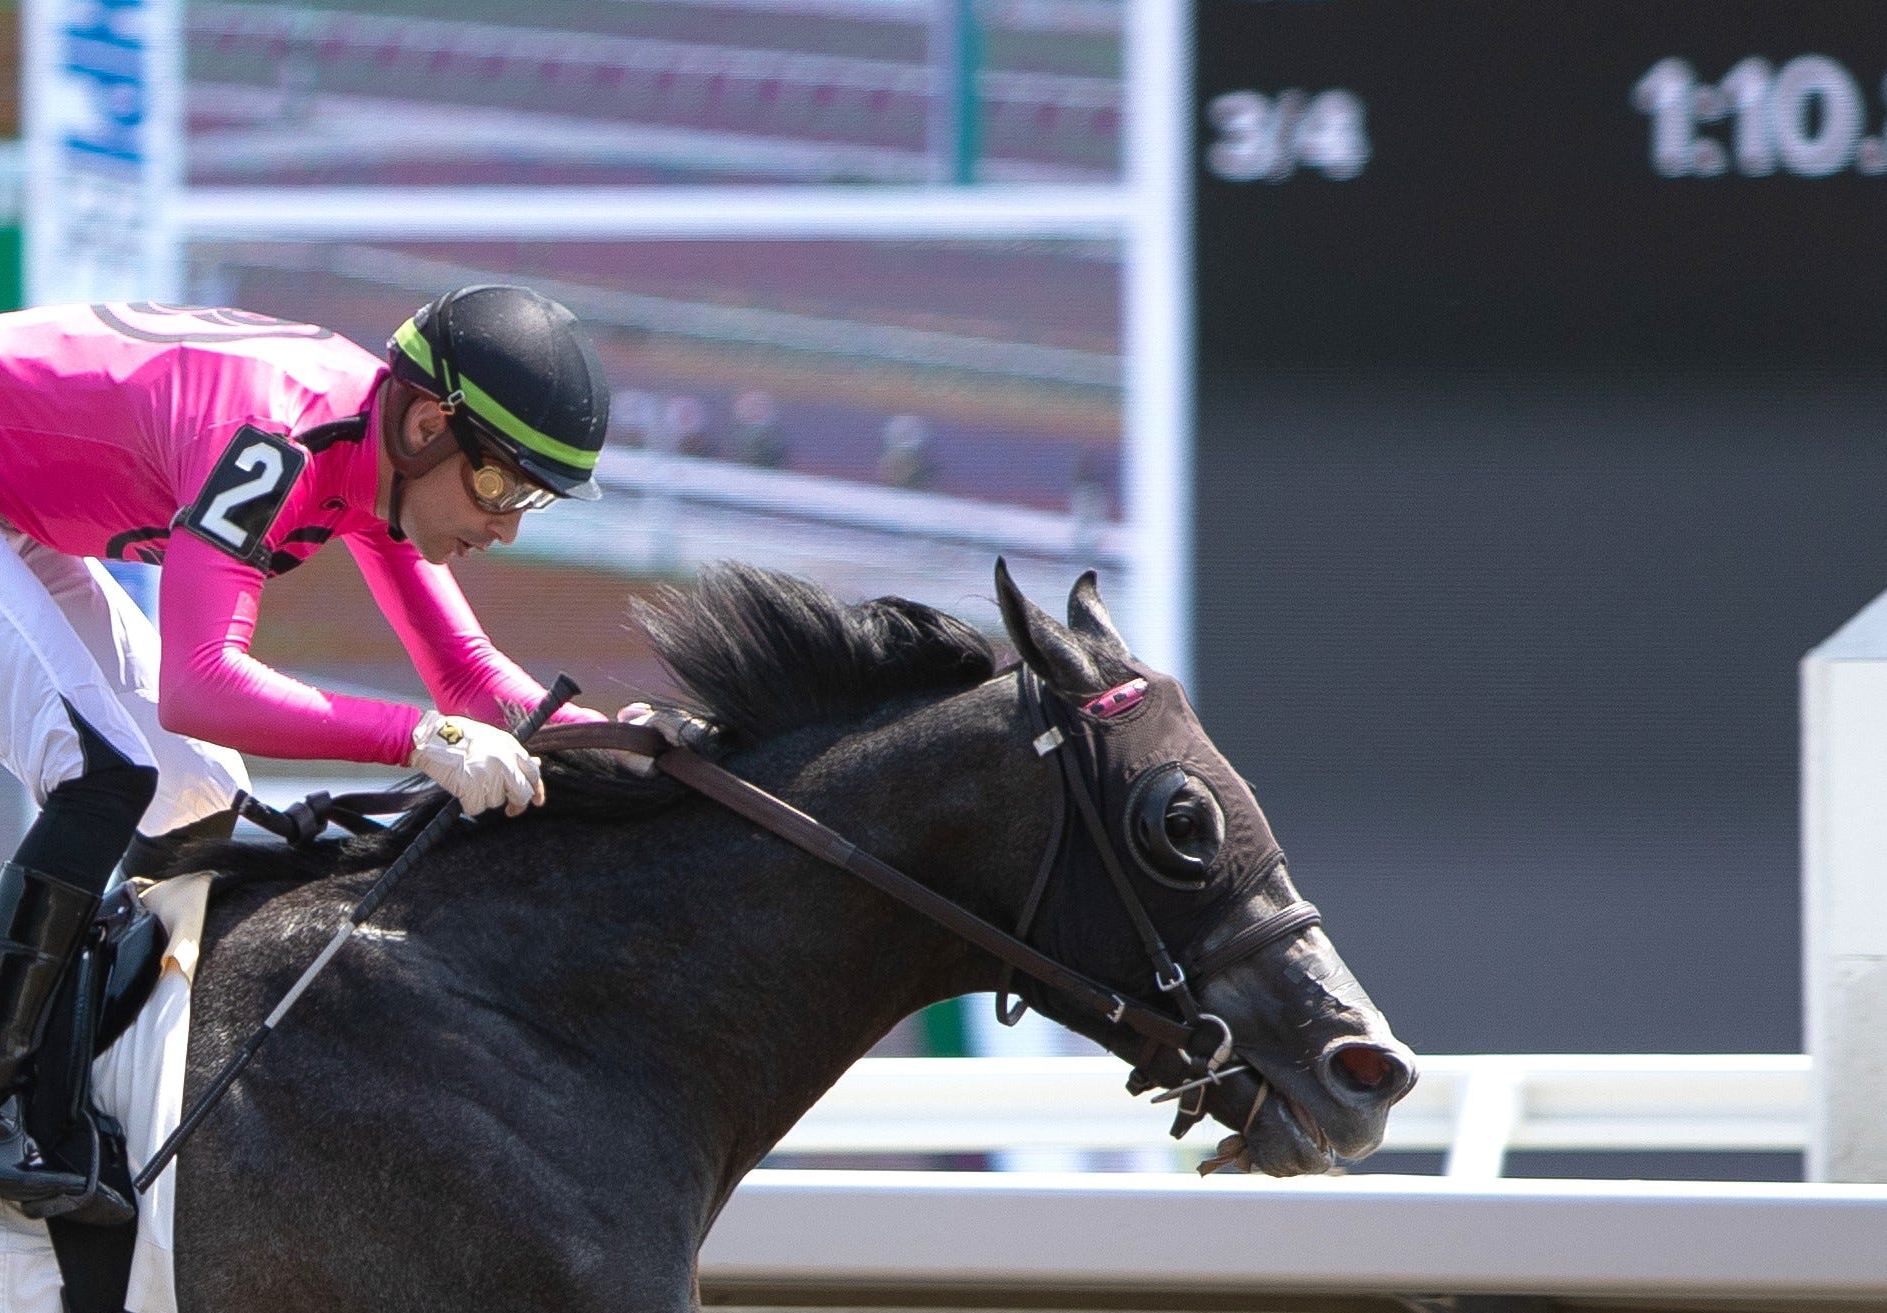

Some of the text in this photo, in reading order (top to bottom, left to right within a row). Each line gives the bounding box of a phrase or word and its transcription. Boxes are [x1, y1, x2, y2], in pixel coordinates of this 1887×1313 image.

[1208, 89, 1369, 182] 3/4
[1629, 54, 1887, 178] 1:10.
[200, 442, 284, 547] 2
